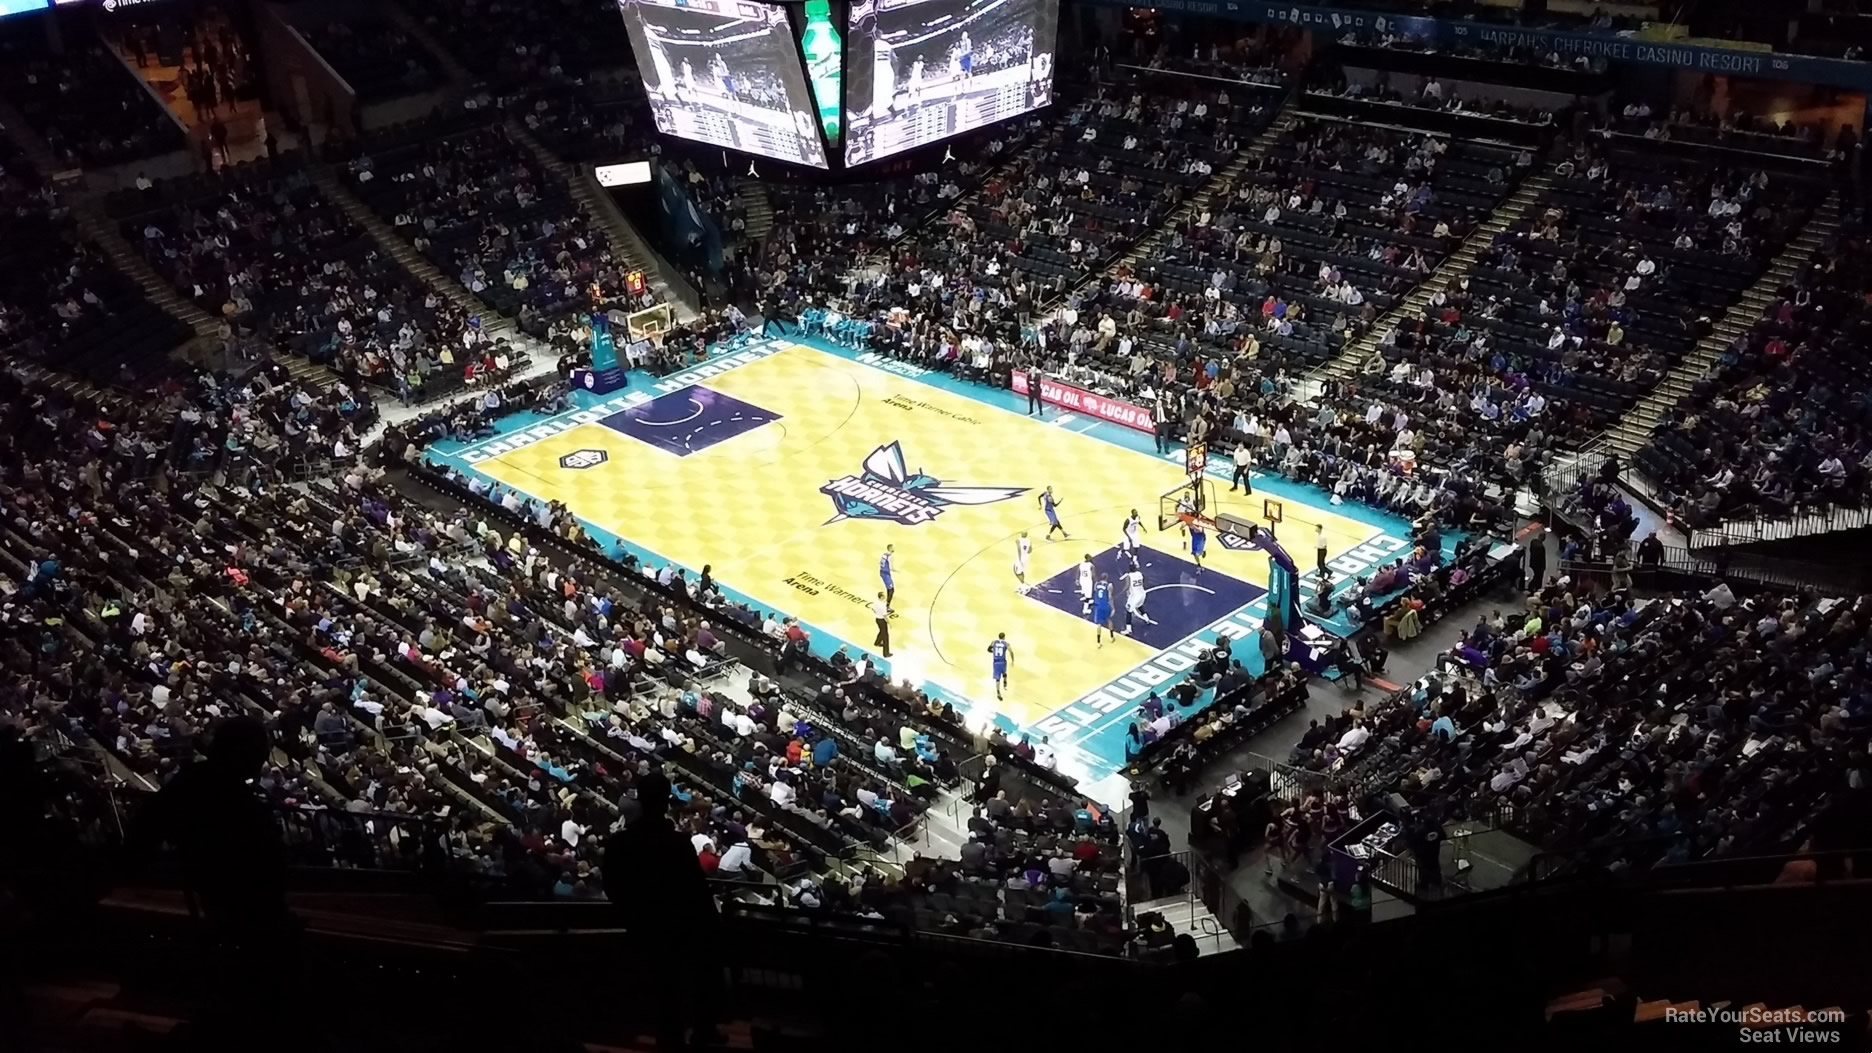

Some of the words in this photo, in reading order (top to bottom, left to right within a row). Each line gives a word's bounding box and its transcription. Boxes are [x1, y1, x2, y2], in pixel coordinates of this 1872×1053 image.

[1454, 26, 1468, 36] 105
[1554, 36, 1631, 60] CHEROKEE
[1636, 45, 1693, 66] CASINO
[1699, 52, 1762, 73] RESORT
[460, 391, 654, 462] CHARLOTTE
[652, 340, 795, 392] HORNETS
[882, 398, 913, 411] Arena
[1062, 390, 1081, 408] OIL
[1100, 403, 1136, 423] LUCAS
[826, 477, 941, 524] HORNETS
[866, 480, 929, 506] CHARLOTTE
[782, 577, 820, 597] Arena
[796, 571, 825, 587] Time
[824, 583, 867, 606] Warner
[1035, 637, 1218, 741] HORNETS
